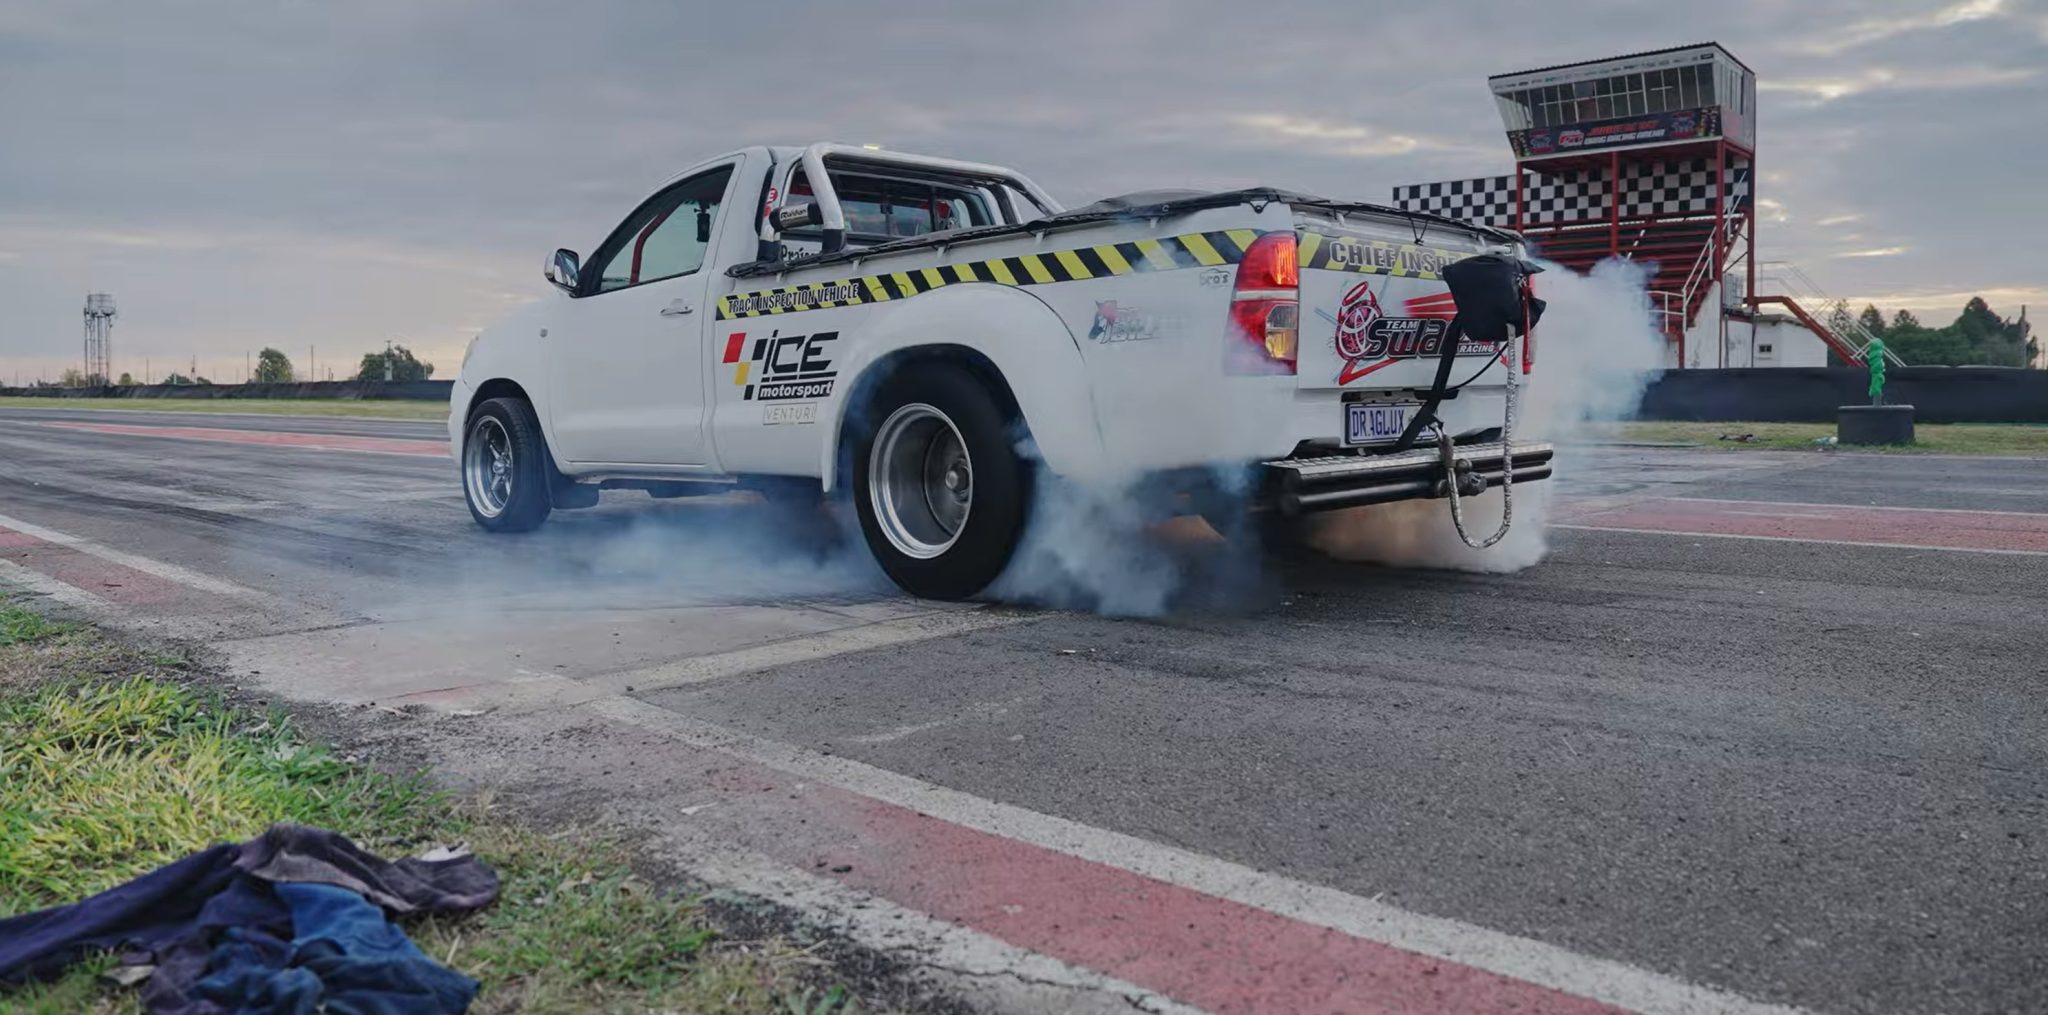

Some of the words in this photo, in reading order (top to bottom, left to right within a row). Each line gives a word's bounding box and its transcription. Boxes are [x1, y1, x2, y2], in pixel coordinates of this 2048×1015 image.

[1329, 240, 1396, 269] CHIEF
[728, 297, 759, 314] TRACK
[758, 289, 815, 311] INSPECTION
[816, 283, 860, 302] VEHICLE
[1386, 320, 1417, 330] TEAM
[1459, 344, 1495, 354] RACING
[759, 380, 833, 398] motorsport
